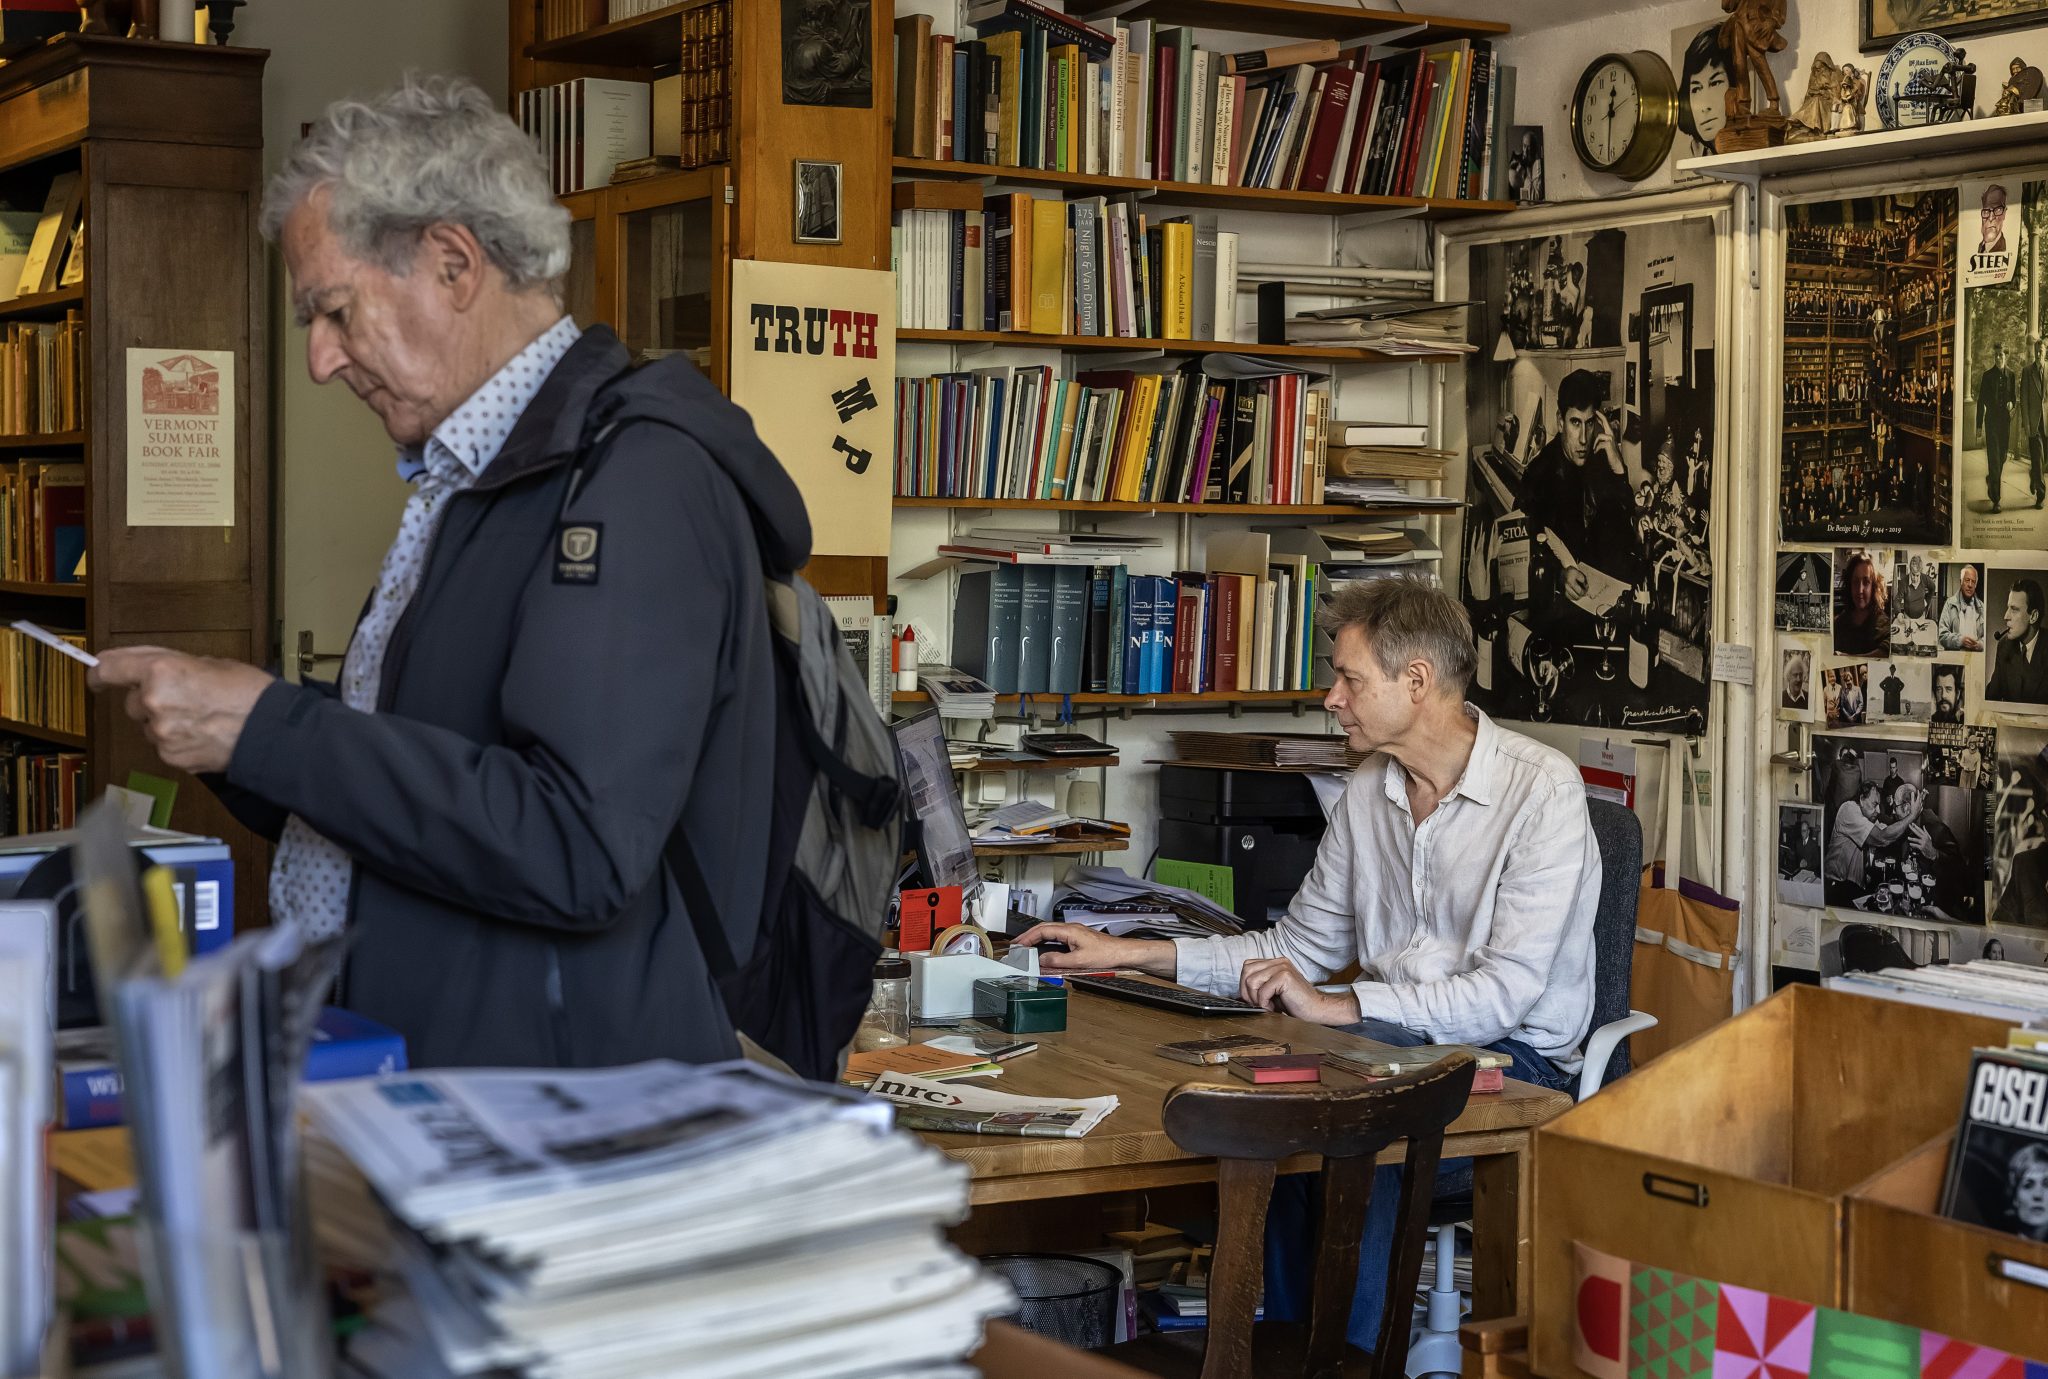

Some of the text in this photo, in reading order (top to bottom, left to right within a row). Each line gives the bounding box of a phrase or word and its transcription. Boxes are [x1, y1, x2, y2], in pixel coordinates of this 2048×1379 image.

[1116, 31, 1124, 96] HERINNERINGEN
[1610, 71, 1616, 82] 12
[1116, 98, 1122, 107] IN
[1590, 96, 1596, 106] 10
[1587, 114, 1592, 125] 9
[1590, 132, 1595, 143] 8
[1599, 144, 1603, 155] 7
[1077, 208, 1093, 218] 175
[1080, 230, 1091, 258] Nijgh
[1196, 238, 1216, 247] Nescio
[1968, 252, 2010, 272] STEEN
[1084, 271, 1092, 290] Van
[1083, 294, 1093, 331] Ditmar
[751, 304, 878, 359] TRUTH
[831, 377, 878, 424] M
[144, 419, 219, 431] VERMONT
[148, 433, 214, 444] SUMMER
[142, 446, 220, 457] BOOK FAIR
[832, 434, 872, 474] P
[1503, 525, 1528, 539] STOA
[1836, 525, 1851, 533] Bezige
[876, 1080, 948, 1103] nrc
[1970, 1062, 2048, 1134] GISEL
